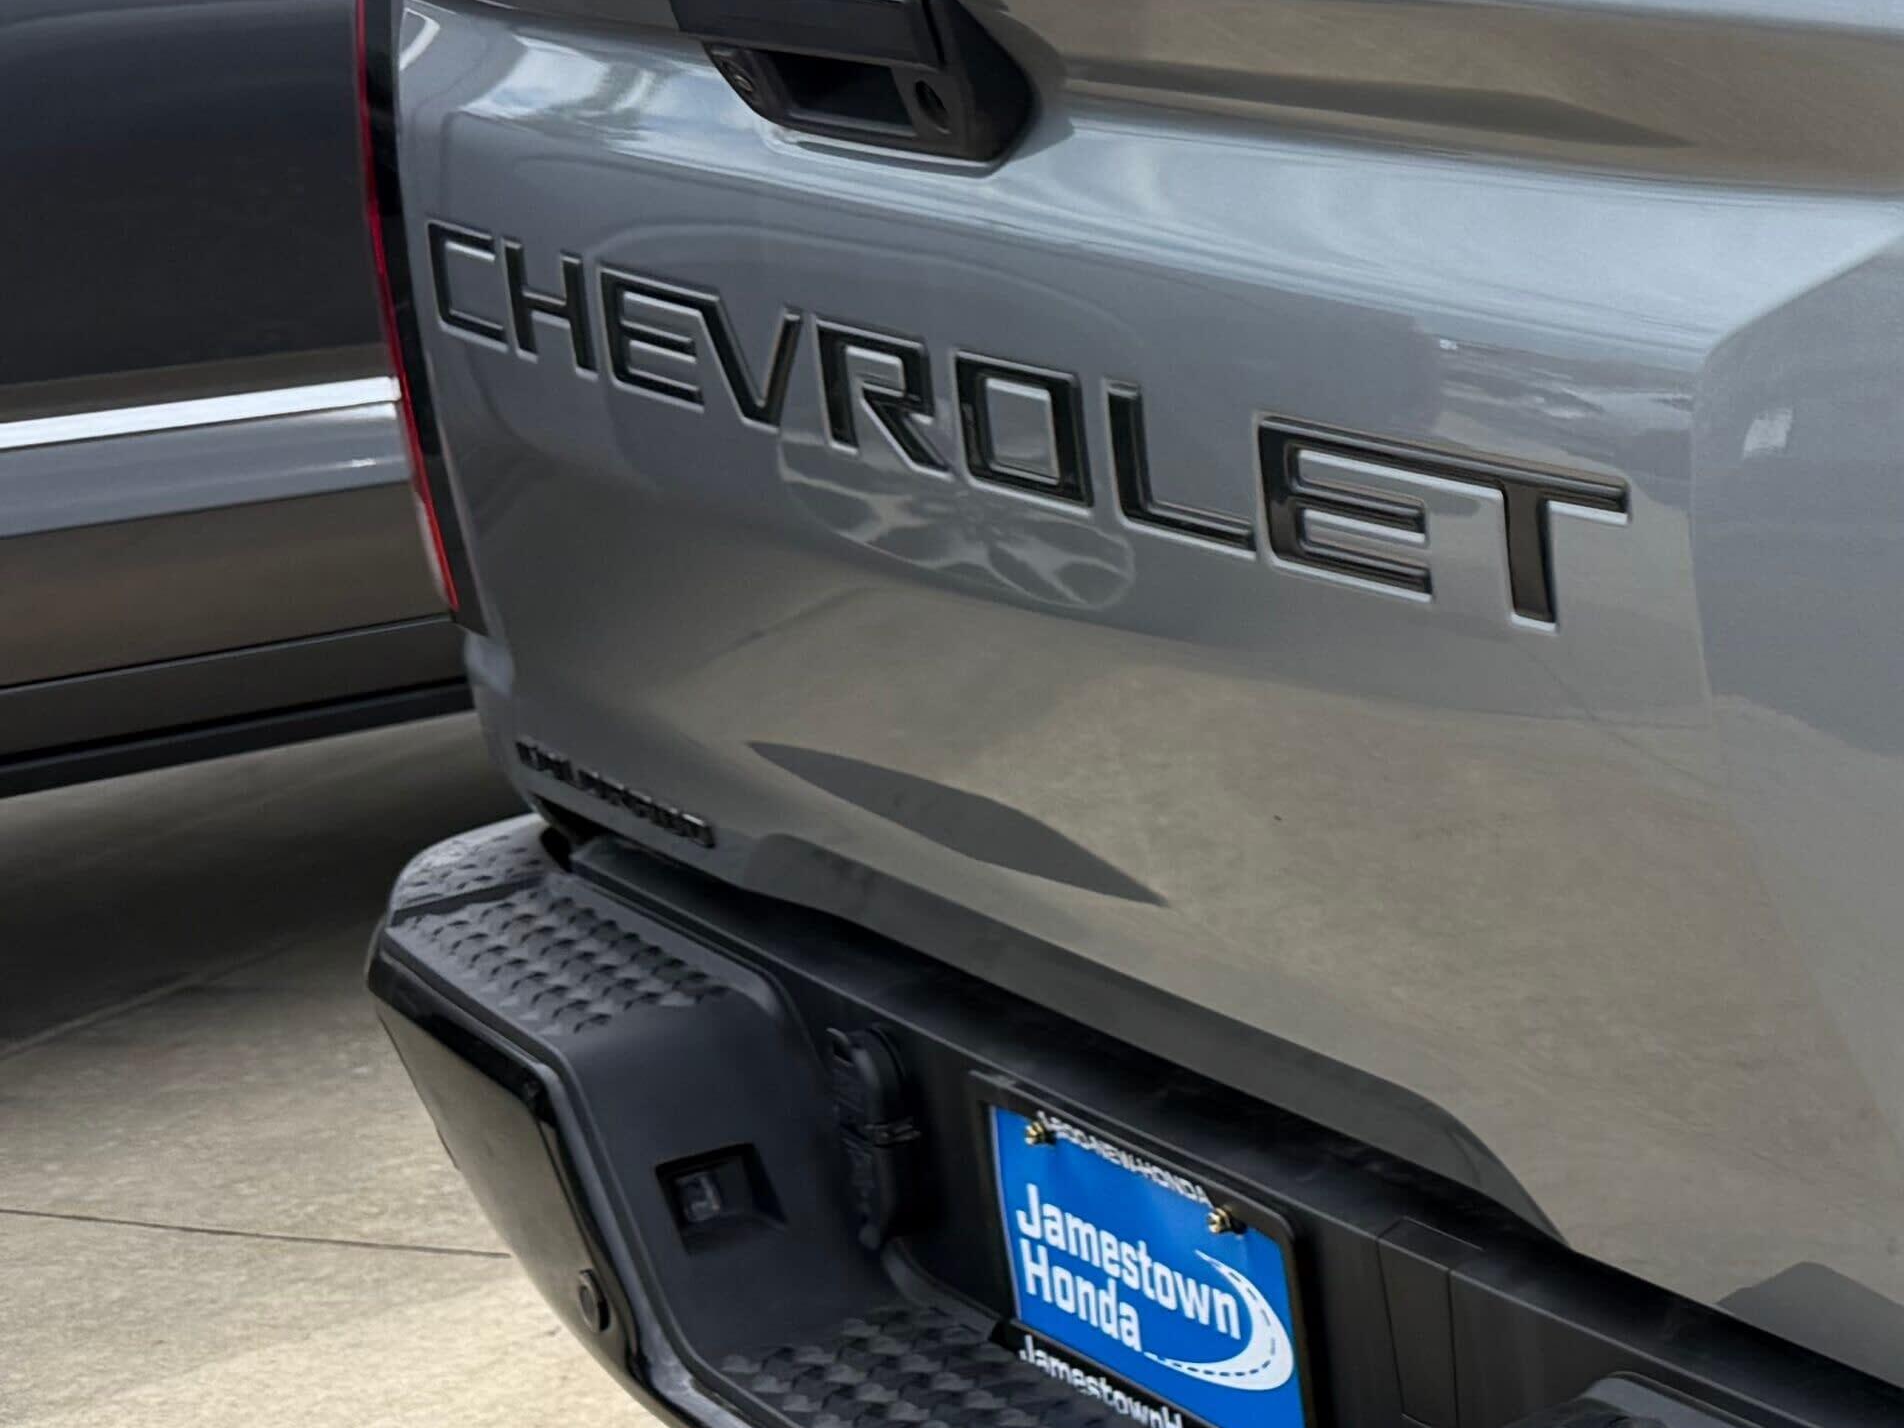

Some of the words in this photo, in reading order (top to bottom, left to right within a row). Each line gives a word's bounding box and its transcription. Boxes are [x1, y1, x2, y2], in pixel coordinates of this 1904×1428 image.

[425, 218, 1630, 631] CHEVROLET
[1016, 1183, 1242, 1340] Jamestown
[1019, 1238, 1143, 1354] Honda
